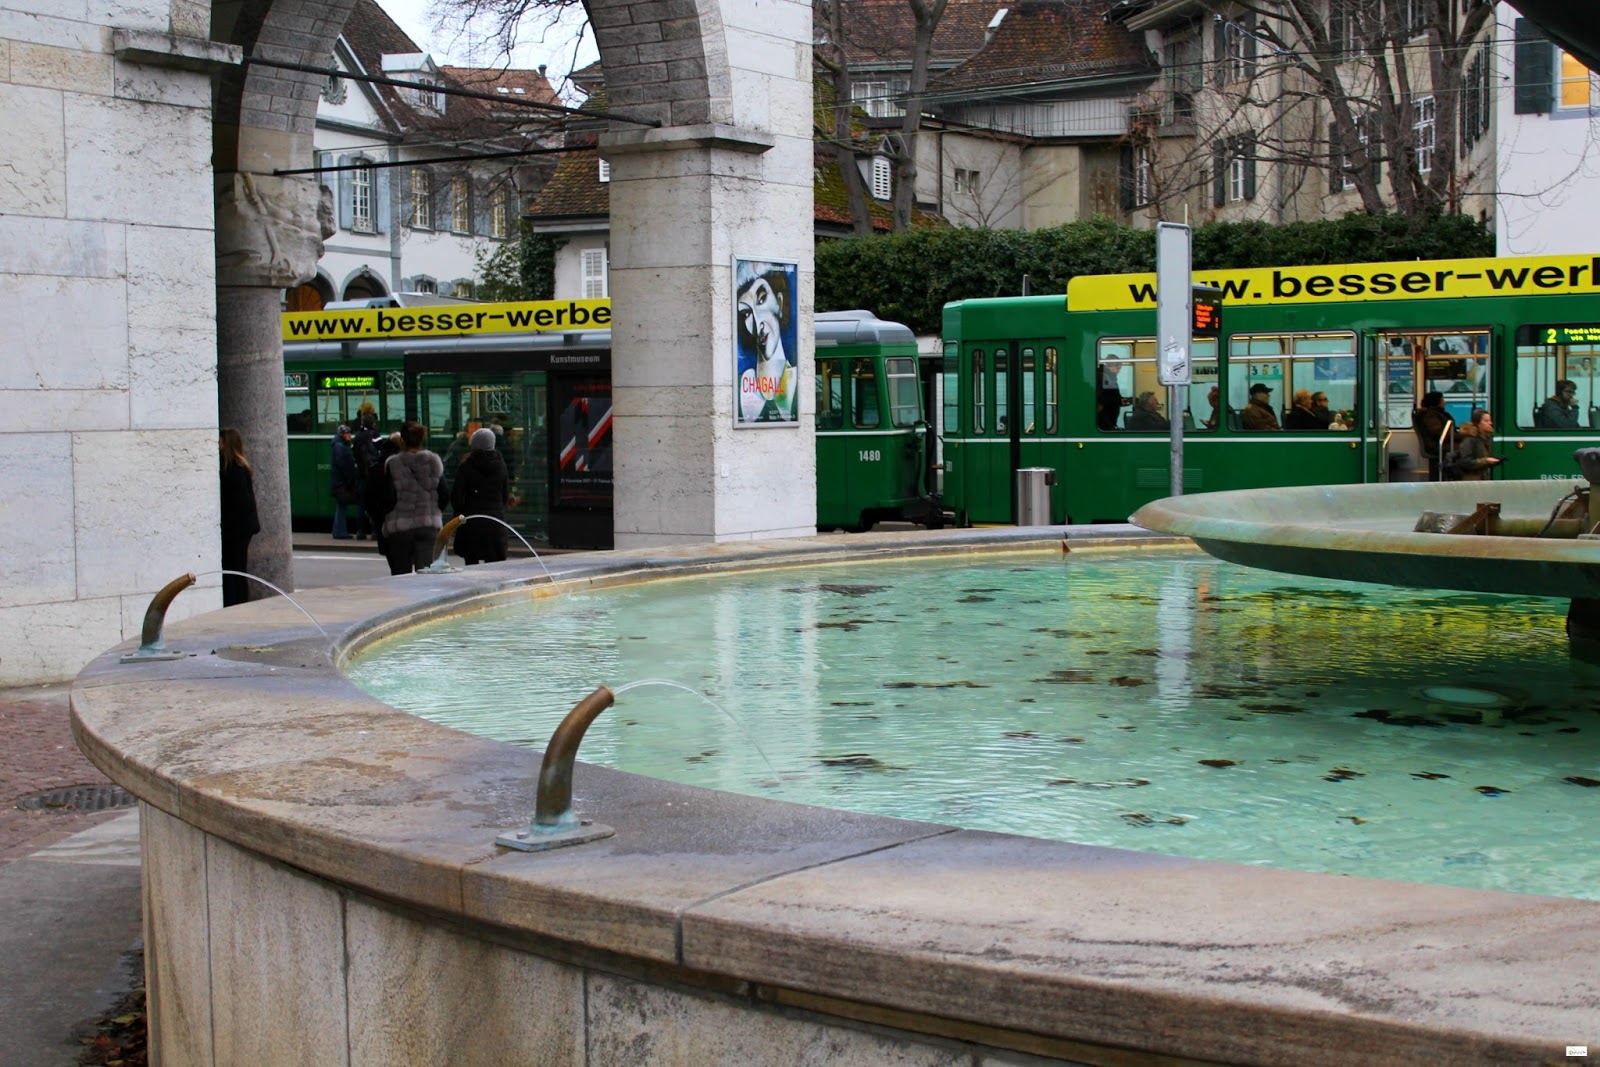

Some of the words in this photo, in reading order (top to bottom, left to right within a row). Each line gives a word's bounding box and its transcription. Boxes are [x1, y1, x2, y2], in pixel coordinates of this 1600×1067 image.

[1129, 257, 1600, 303] ww.besser-wer
[1547, 328, 1557, 344] 2
[550, 354, 600, 364] Kunstmuseum
[325, 377, 331, 388] 2
[742, 376, 785, 394] CHAGALL
[858, 449, 880, 463] 1480
